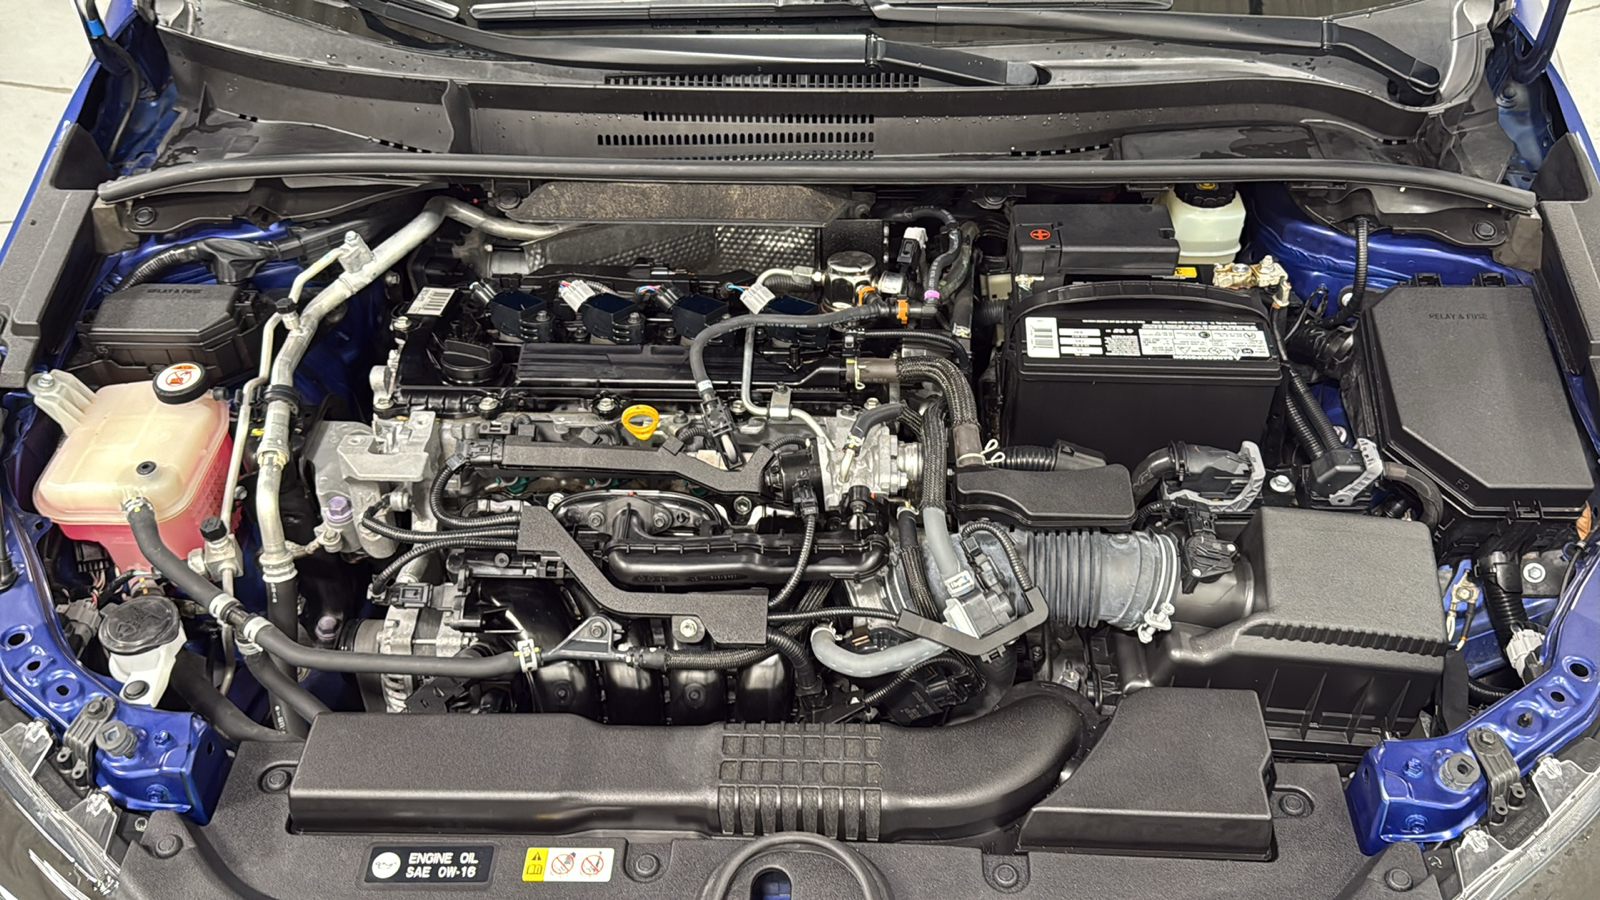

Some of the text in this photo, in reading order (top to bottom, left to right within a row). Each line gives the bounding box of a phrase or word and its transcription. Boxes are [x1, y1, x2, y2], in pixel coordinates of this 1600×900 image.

[408, 852, 479, 864] ENGINE OIL
[405, 866, 477, 878] SAE 0W-16
